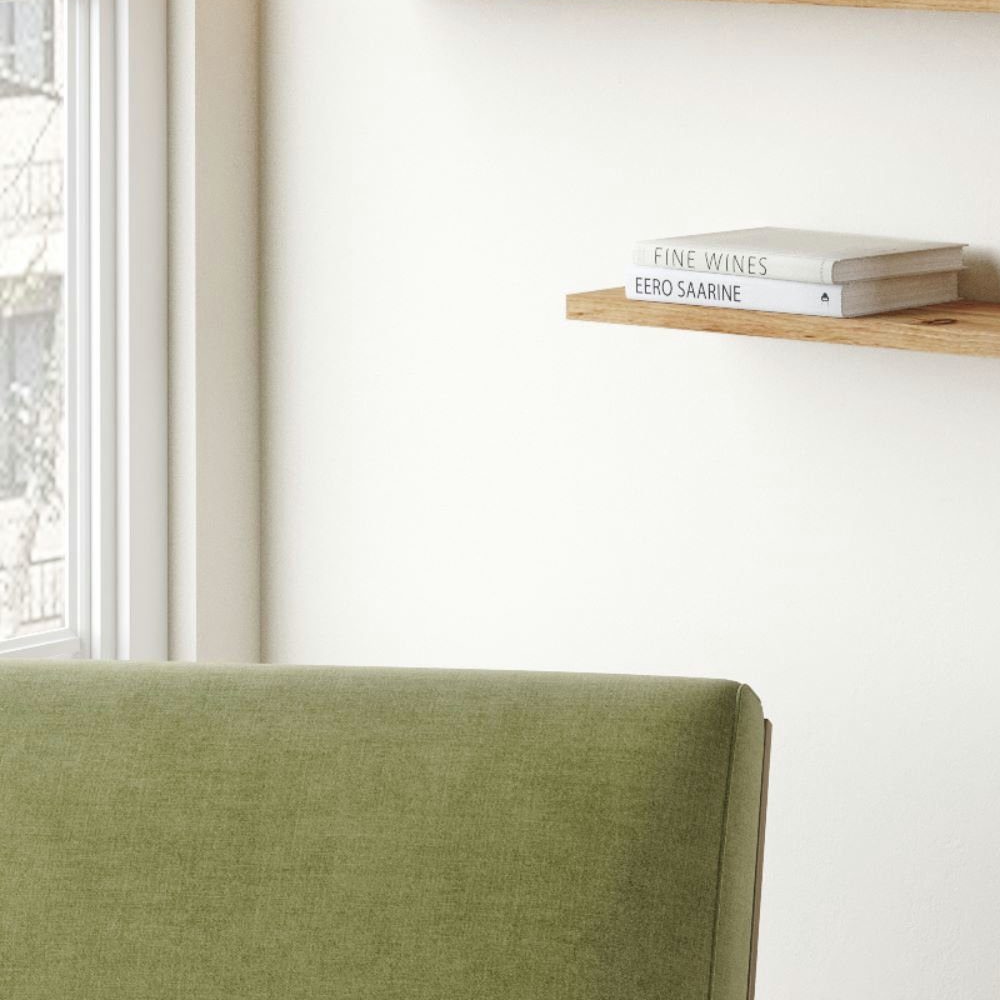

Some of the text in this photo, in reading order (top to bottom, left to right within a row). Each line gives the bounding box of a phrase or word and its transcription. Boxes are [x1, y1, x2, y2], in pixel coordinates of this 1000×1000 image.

[654, 247, 768, 276] FINE WINES
[635, 276, 742, 303] EERO SAARINE
